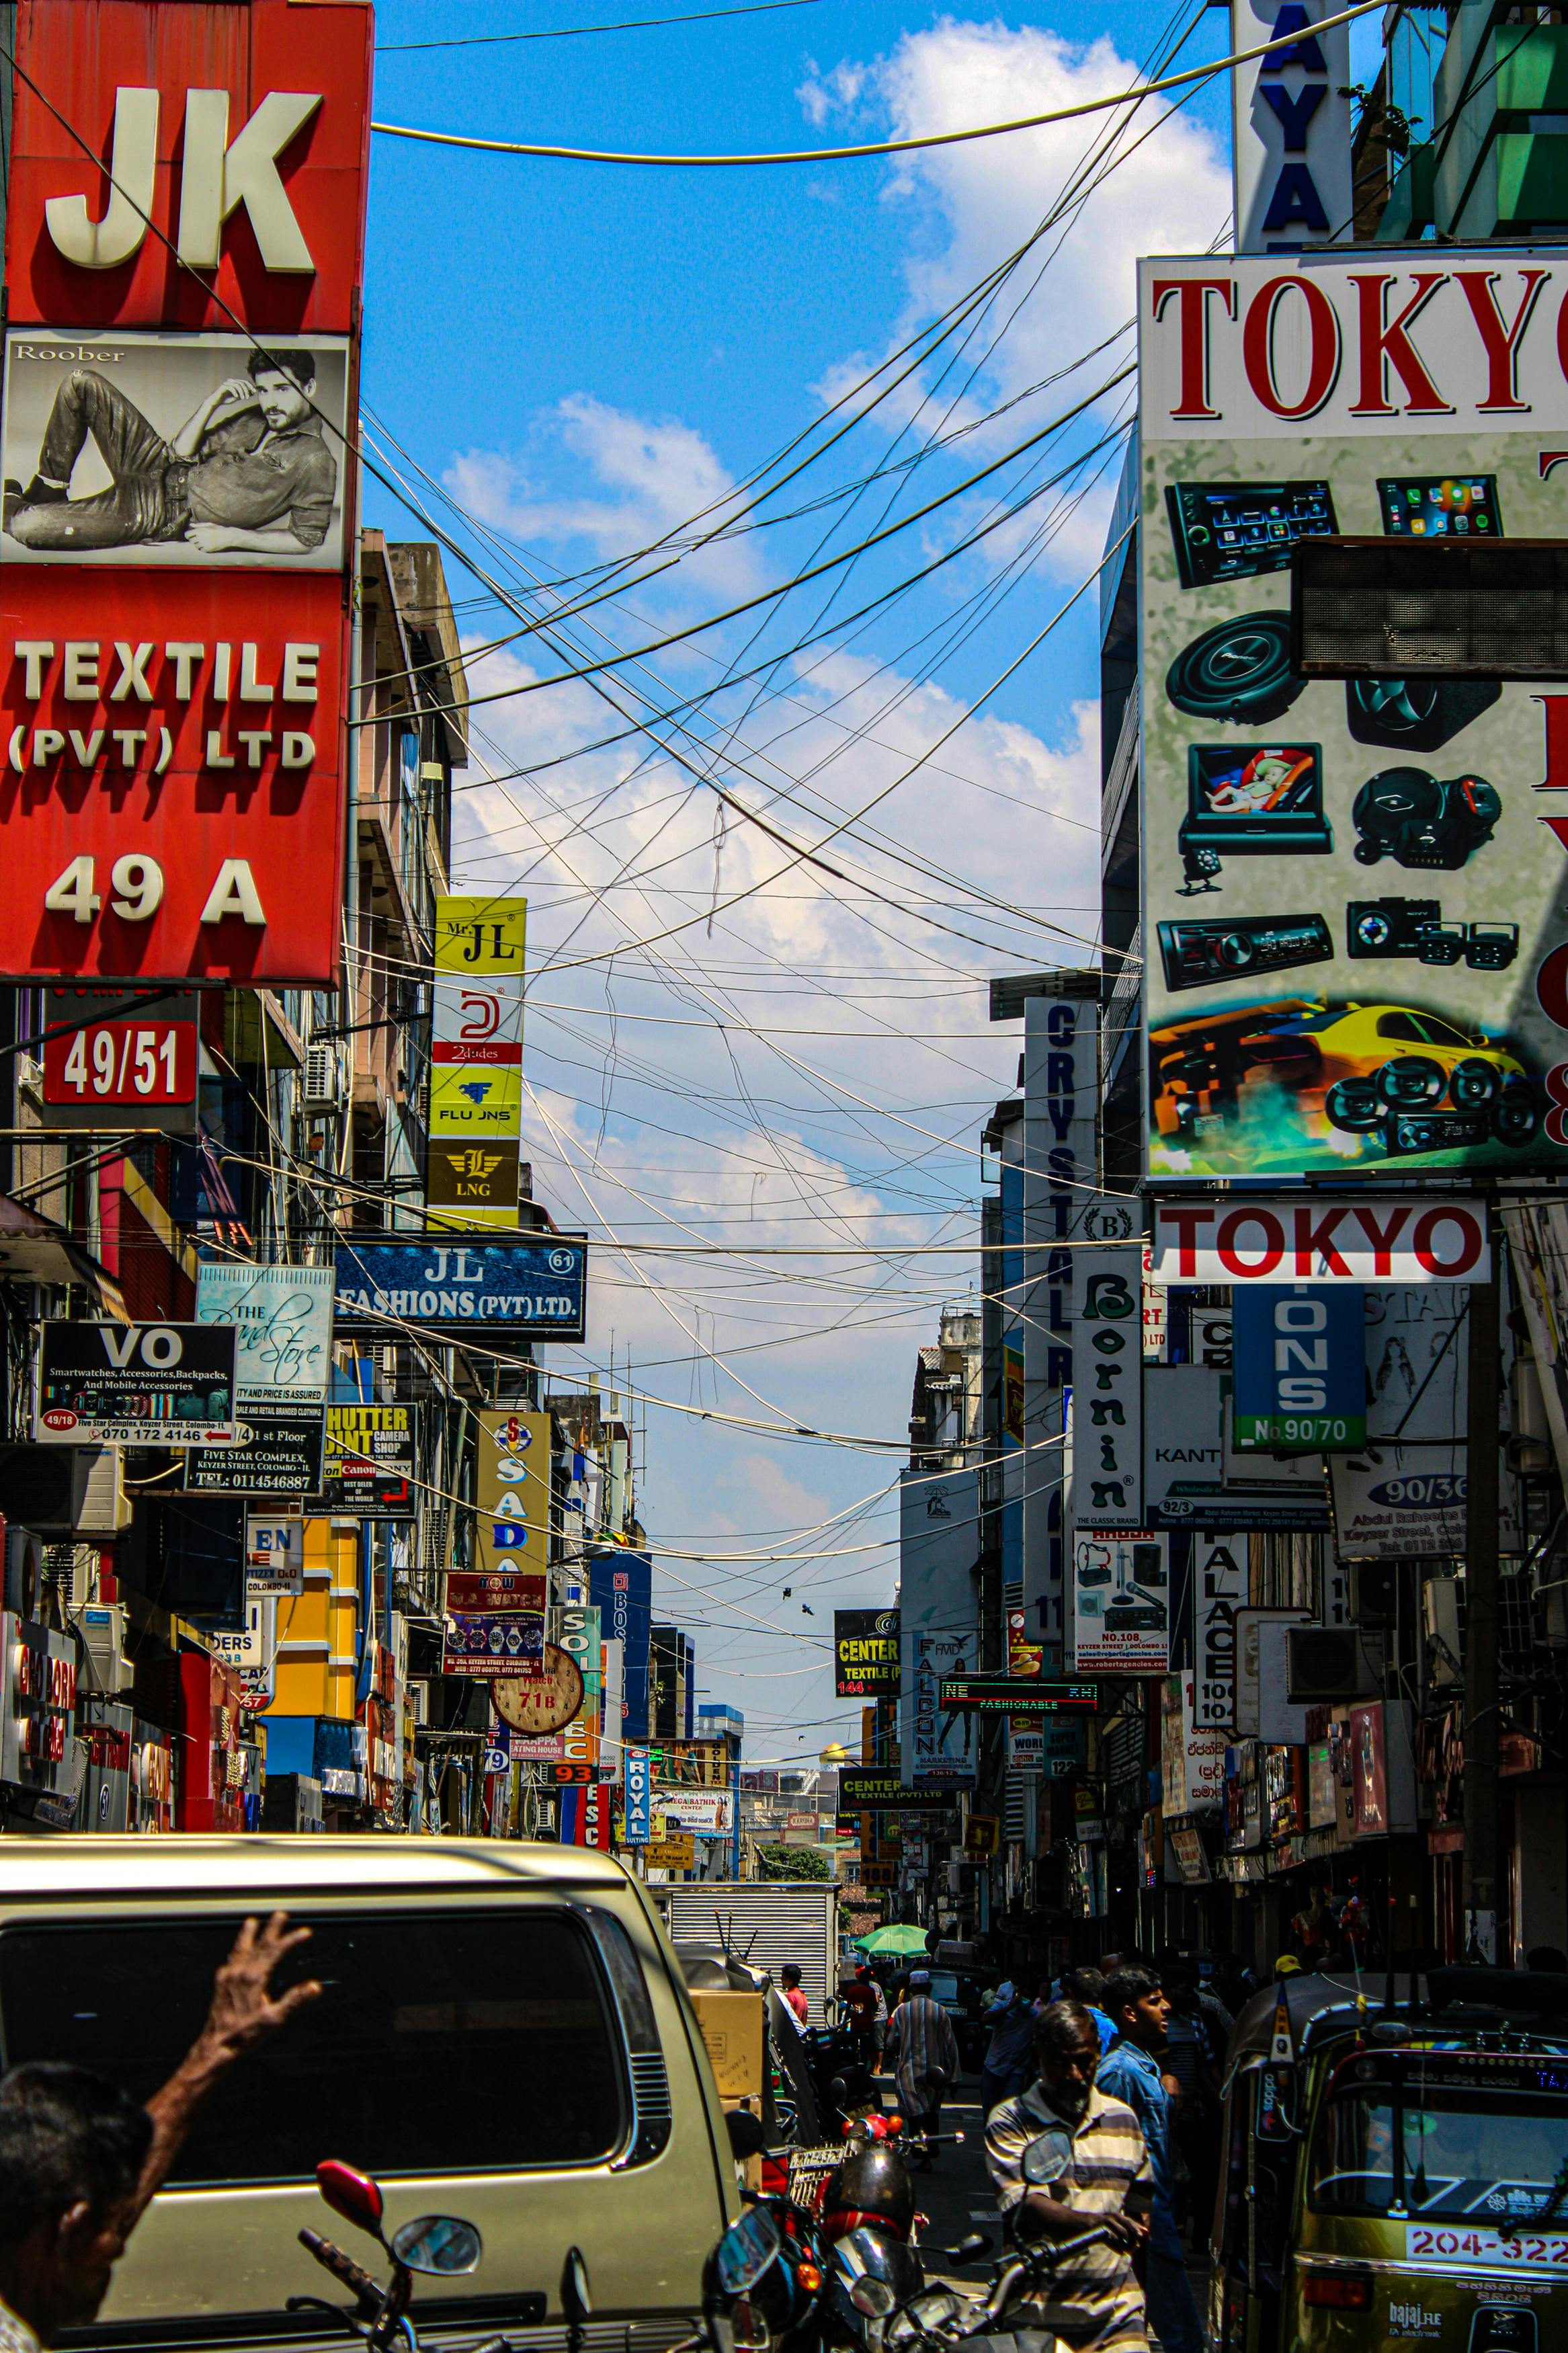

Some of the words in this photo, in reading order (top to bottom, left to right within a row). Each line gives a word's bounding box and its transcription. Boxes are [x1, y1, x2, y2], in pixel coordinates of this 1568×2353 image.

[45, 87, 323, 274] JK
[1152, 269, 1568, 422] TOKY
[15, 345, 124, 364] Roober
[15, 641, 321, 703] TEXTILE
[9, 725, 173, 775] (PVT)
[206, 730, 316, 768] LTD
[45, 853, 165, 924] 49
[200, 859, 267, 925] A
[447, 922, 473, 934] Mr.
[463, 924, 515, 962] JL
[452, 1045, 498, 1060] 2dudes
[65, 1030, 176, 1094] 49/51
[456, 1183, 490, 1196] LNG
[1102, 1215, 1118, 1237] B
[1159, 1207, 1482, 1277] TOKYO
[425, 1248, 484, 1282] JL
[552, 1255, 573, 1267] 61
[337, 1289, 474, 1318] FASHIONS
[478, 1297, 532, 1319] (PVT)
[536, 1297, 576, 1316] LTD.
[237, 1306, 265, 1319] THE
[1143, 1309, 1162, 1325] RT
[1150, 1334, 1165, 1345] LTD
[99, 1328, 182, 1369] VO
[1274, 1286, 1328, 1410] ONS
[50, 1368, 118, 1378] Smartwatches,
[83, 1380, 102, 1389] And
[105, 1381, 136, 1390] Mobile
[138, 1382, 193, 1391] Accessories
[1081, 1273, 1135, 1508] Bornin
[248, 1390, 262, 1398] AND
[263, 1390, 282, 1399] PRICE
[284, 1390, 290, 1398] IS
[290, 1390, 321, 1400] ASSURED
[47, 1414, 73, 1425] 49/18
[93, 1419, 106, 1427] Star
[327, 1408, 407, 1430] HUTTER
[102, 1429, 128, 1439] 070
[134, 1429, 160, 1440] 172
[165, 1431, 200, 1441] 4146
[263, 1432, 274, 1441] st
[276, 1430, 306, 1442] Floor
[374, 1431, 410, 1441] CAMERA
[325, 1431, 373, 1455] OINT
[374, 1443, 401, 1453] SHOP
[204, 1450, 225, 1460] FIVE
[228, 1451, 253, 1462] STAR
[256, 1452, 306, 1464] COMPLEX,
[1156, 1449, 1221, 1462] KANT
[198, 1461, 226, 1470] KEYZER
[257, 1463, 296, 1472] COLOMBO
[342, 1466, 376, 1474] Canon
[233, 1474, 310, 1490] 0114546887
[1163, 1502, 1189, 1513] 92/3
[1352, 1514, 1393, 1527] Abdul
[247, 1569, 274, 1579] ITIZEN
[1102, 1634, 1142, 1643] NO.108,
[839, 1640, 899, 1662] CENTER
[845, 1667, 888, 1679] TEXTILE
[838, 1681, 864, 1693] 144
[243, 1697, 261, 1708] 57
[555, 1767, 592, 1782] 93
[844, 1780, 902, 1792] CENTER
[629, 1761, 646, 1835] ROYAL
[897, 1791, 923, 1800] (PVT)
[1264, 2073, 1278, 2111] adidas
[1389, 2301, 1421, 2329] bajaj
